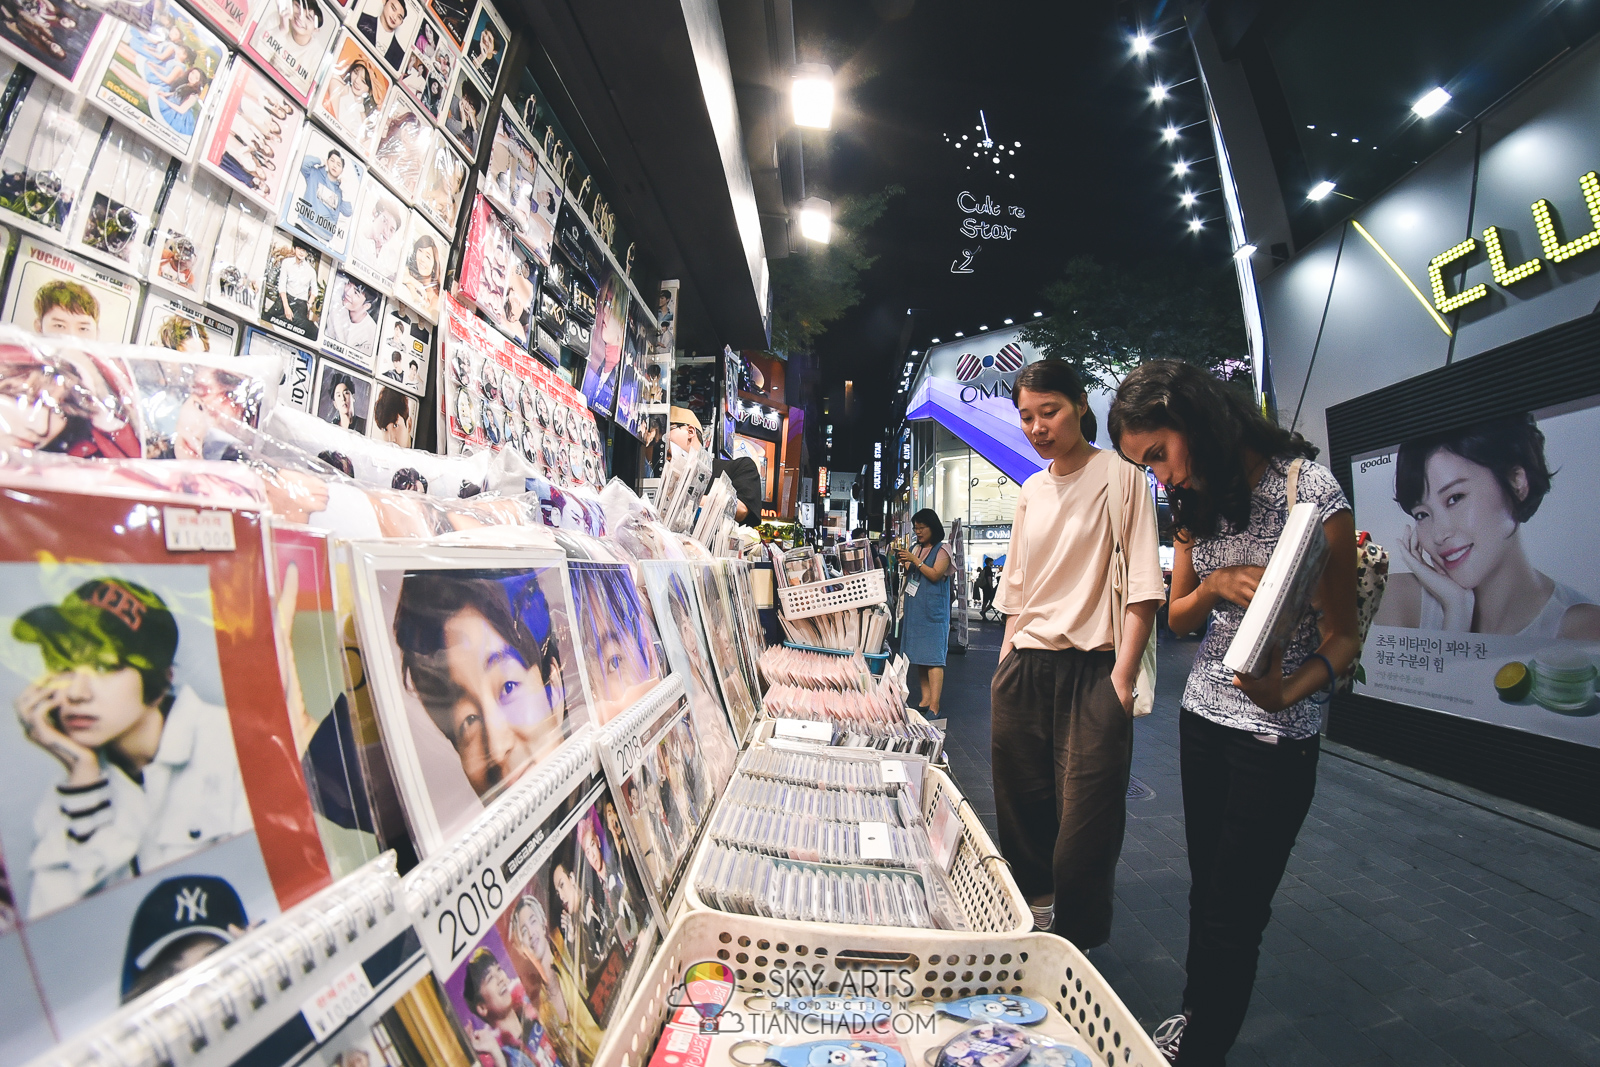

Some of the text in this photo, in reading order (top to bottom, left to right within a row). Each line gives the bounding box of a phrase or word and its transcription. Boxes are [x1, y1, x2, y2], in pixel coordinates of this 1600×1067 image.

[262, 31, 309, 81] PARK SEO JUN
[295, 202, 345, 240] SONG JOONG KI
[959, 217, 1017, 241] Star
[30, 246, 75, 273] YUCHUN
[269, 316, 306, 336] PARK SI HOO
[873, 442, 882, 490] CULTURE STAR
[1360, 453, 1392, 474] goodal
[1376, 634, 1396, 650] 초록
[1399, 635, 1442, 655] 비타민이
[1474, 643, 1488, 660] 찬
[1376, 650, 1444, 673] 청귤 수분의 힘
[616, 735, 643, 778] 2018
[438, 867, 503, 962] 2018
